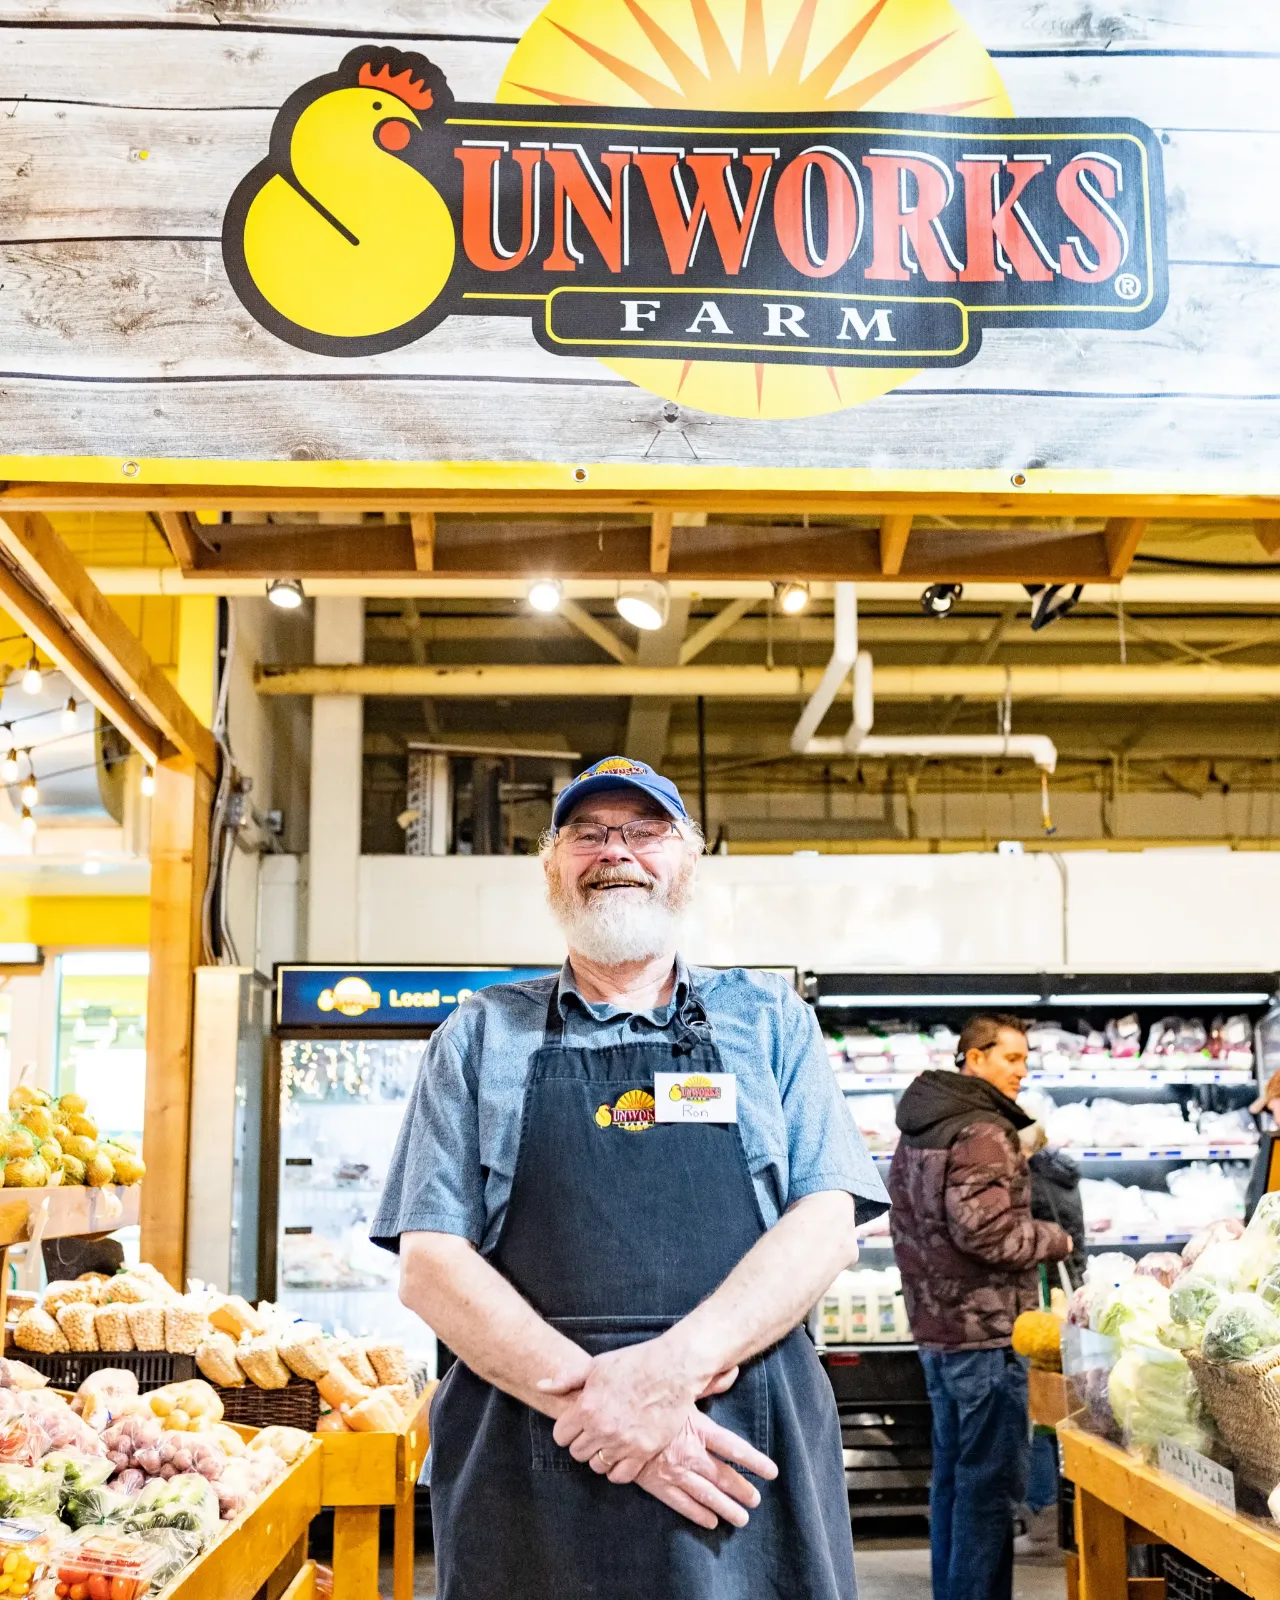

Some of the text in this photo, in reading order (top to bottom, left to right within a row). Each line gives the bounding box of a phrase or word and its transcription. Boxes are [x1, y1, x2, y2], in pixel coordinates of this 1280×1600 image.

[620, 300, 897, 342] FARM
[595, 1105, 655, 1126] SUNWOR
[682, 1104, 709, 1117] Ron
